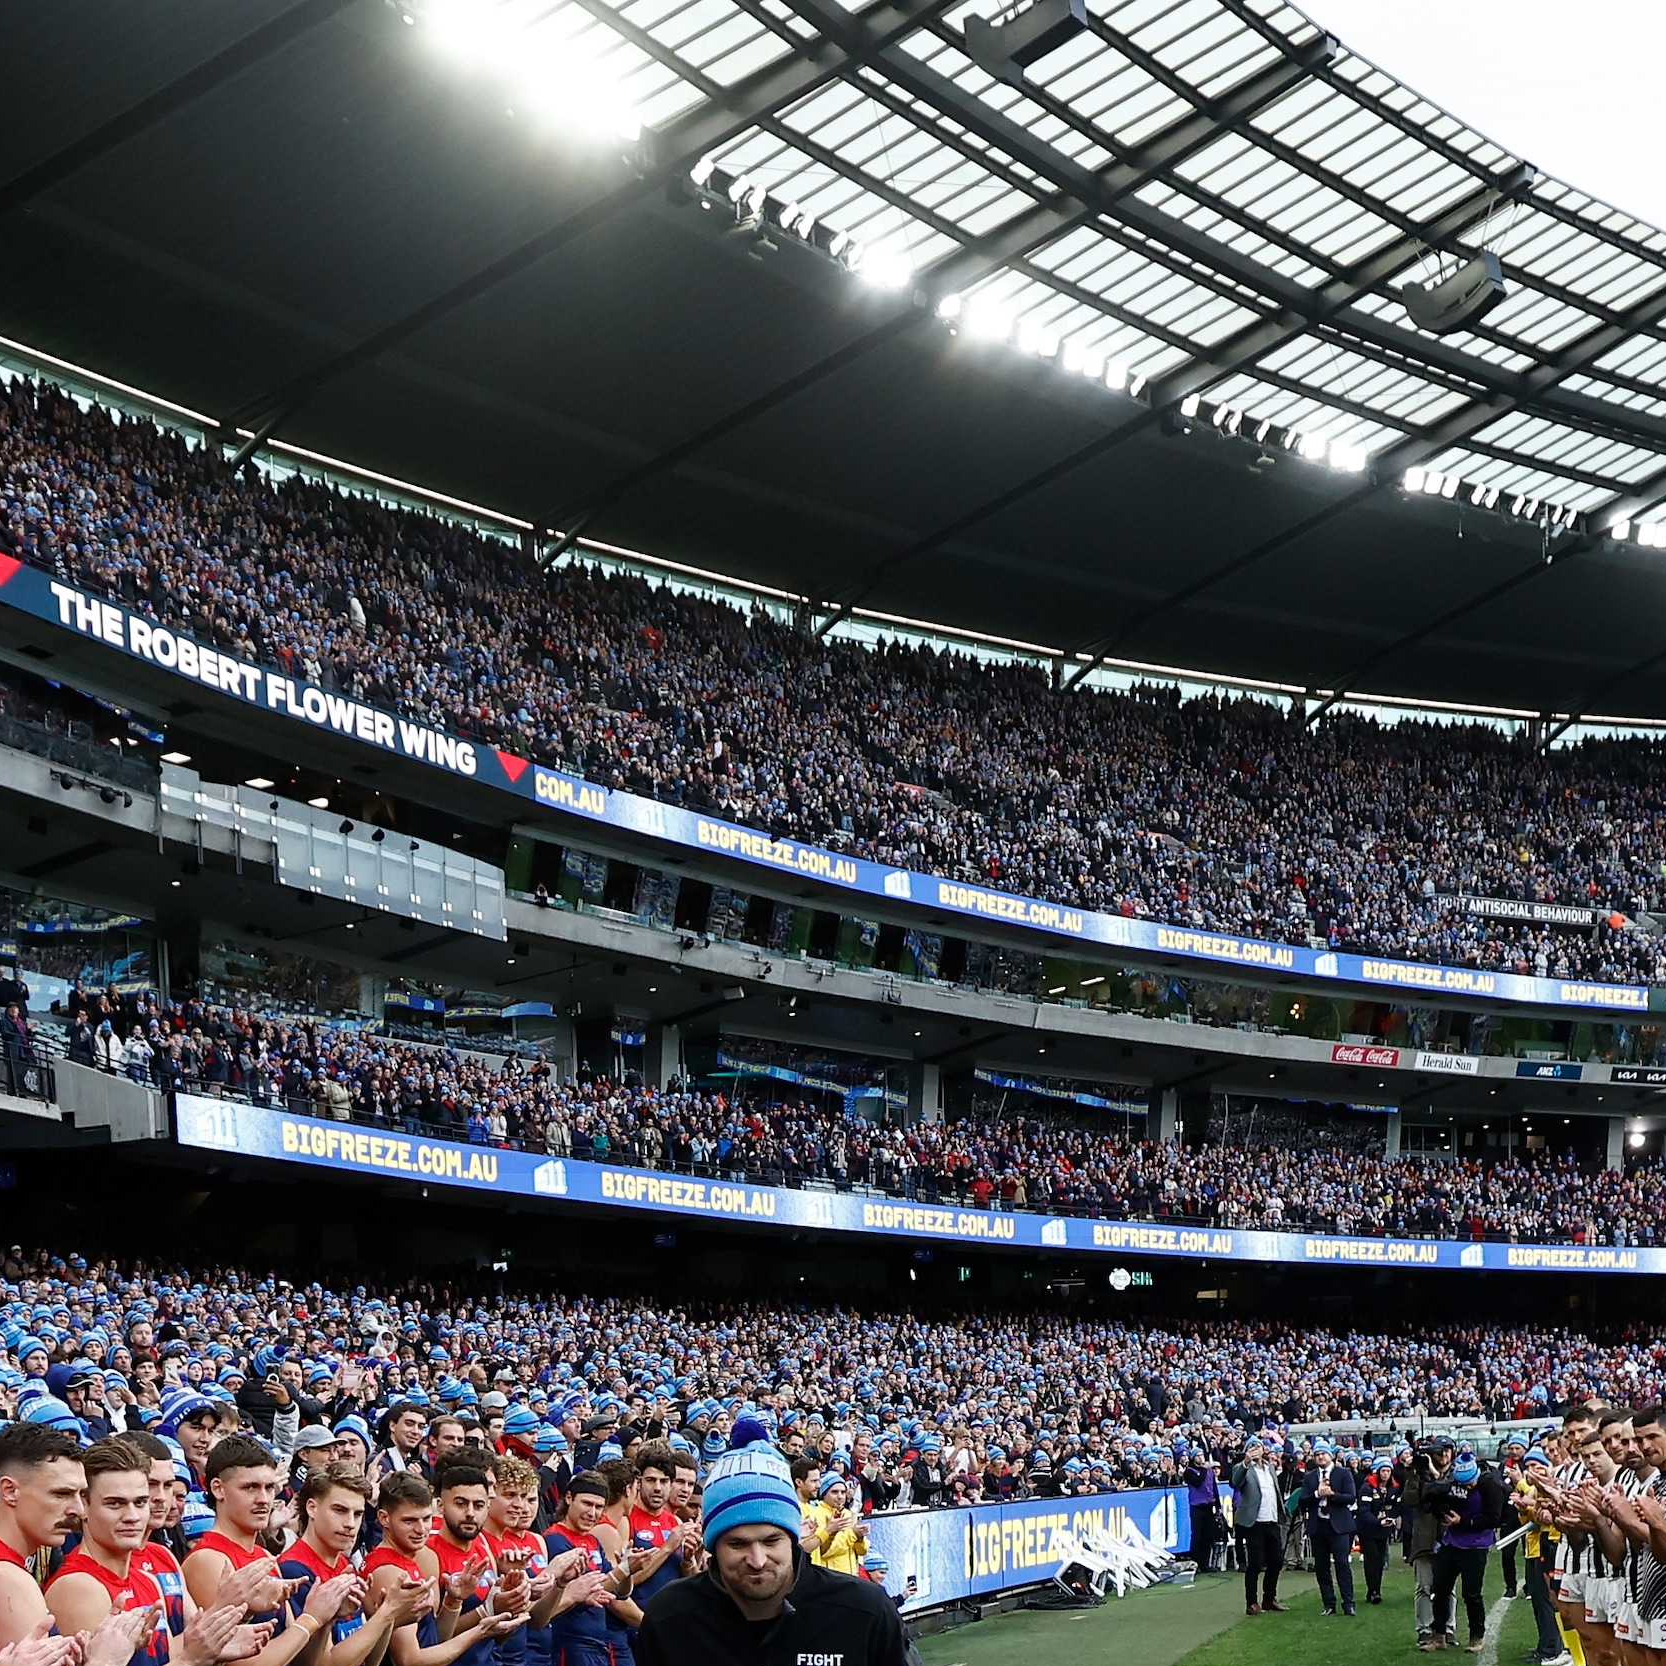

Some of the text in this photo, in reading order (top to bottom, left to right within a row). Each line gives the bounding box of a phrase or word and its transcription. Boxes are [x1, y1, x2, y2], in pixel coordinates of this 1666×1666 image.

[49, 581, 479, 778] THE ROBERT FLOWER WING
[697, 820, 858, 883] BIGFREEZE.COM.AU
[938, 882, 1083, 932] BIGFREEZE.COM.AU
[1469, 899, 1593, 924] ANTISOCIAL BEHAVIOUR
[1157, 927, 1294, 968] BIGFREEZE.COM.AU
[1362, 960, 1495, 992] BIGFREEZE.COM.AU
[1422, 1055, 1472, 1072] Herald Sun
[282, 1121, 498, 1183] BIGFREEZE.COM.AU
[601, 1171, 775, 1217] BIGFREEZE.COM.AU
[862, 1203, 1015, 1239] BIGFREEZE.COM.AU
[1093, 1225, 1232, 1255] BIGFREEZE.COM.AU
[1306, 1239, 1438, 1263] BIGFREEZE.COM.AU
[1508, 1248, 1636, 1269] BIGFREEZE.COM.AU
[796, 1653, 844, 1666] FIGHT
